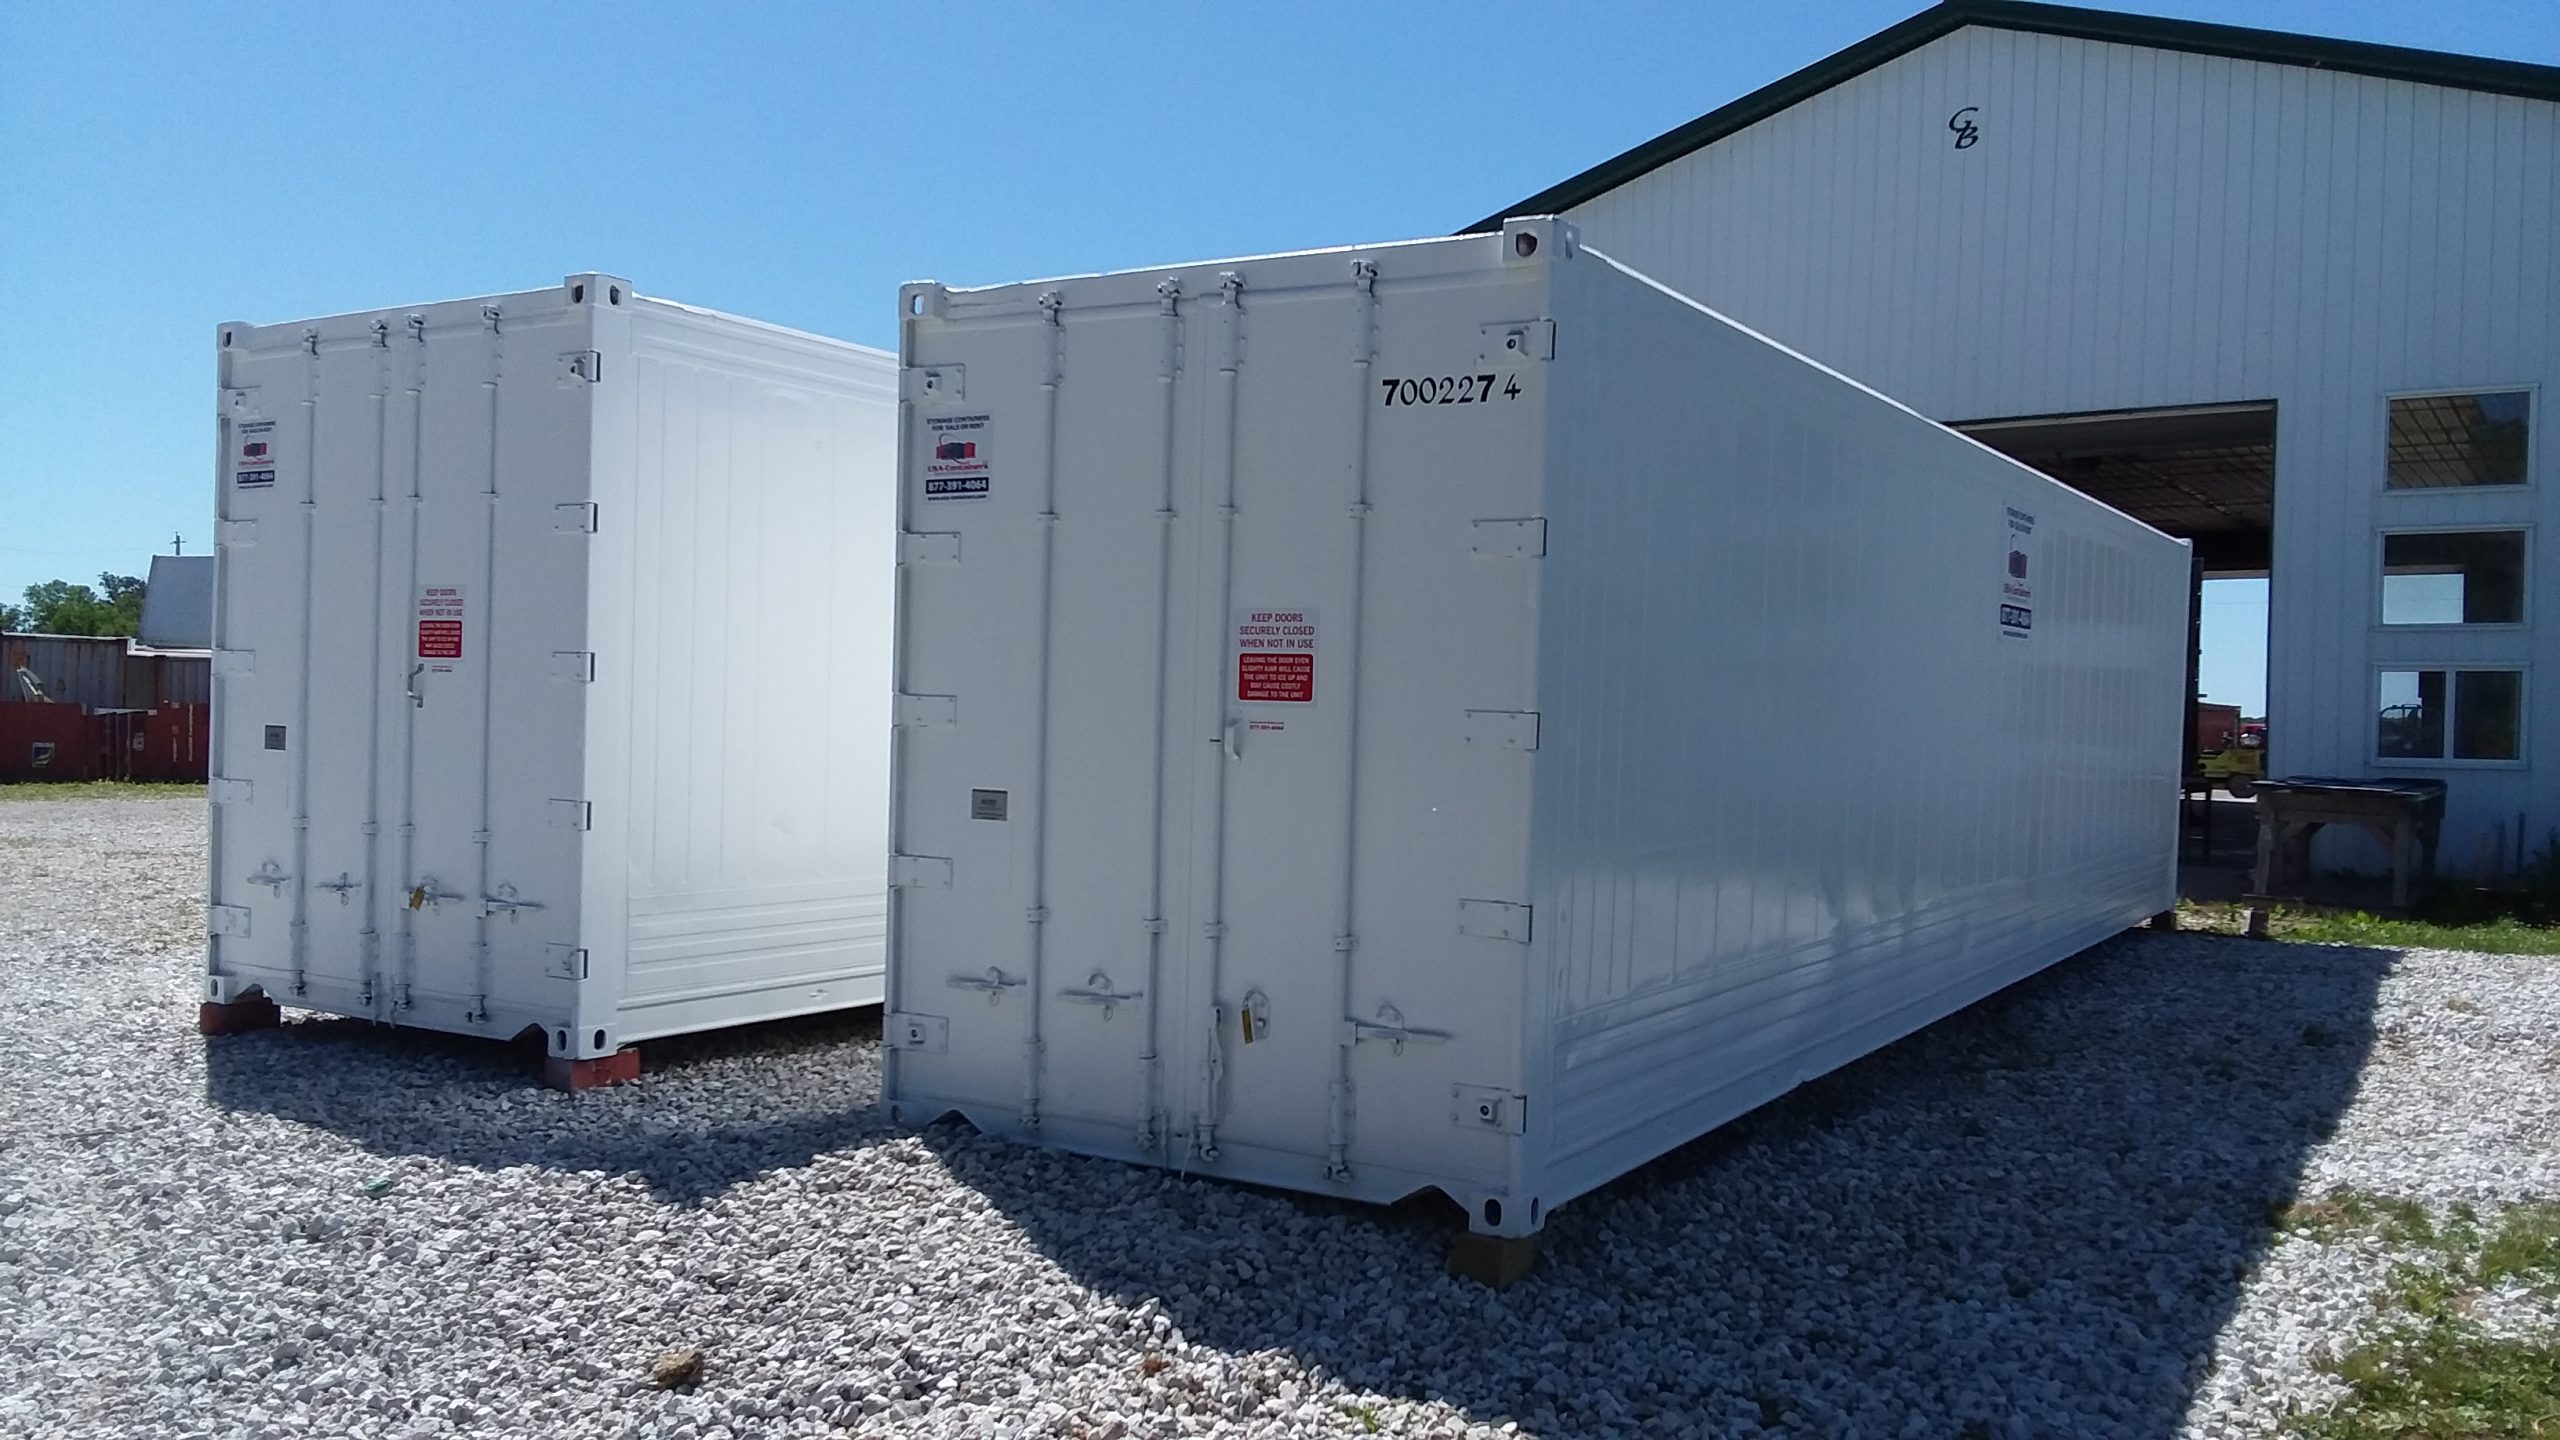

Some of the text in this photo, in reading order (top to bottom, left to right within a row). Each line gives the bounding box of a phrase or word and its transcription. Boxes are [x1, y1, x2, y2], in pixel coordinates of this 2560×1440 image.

[928, 479, 987, 491] 877-391-4064
[1251, 613, 1303, 622] KEEP DOORS
[1240, 626, 1315, 635] SECURELY CLOSED
[1240, 638, 1314, 648] WHEN NOT IN USE
[1267, 656, 1277, 664] THE
[1270, 690, 1278, 698] TO
